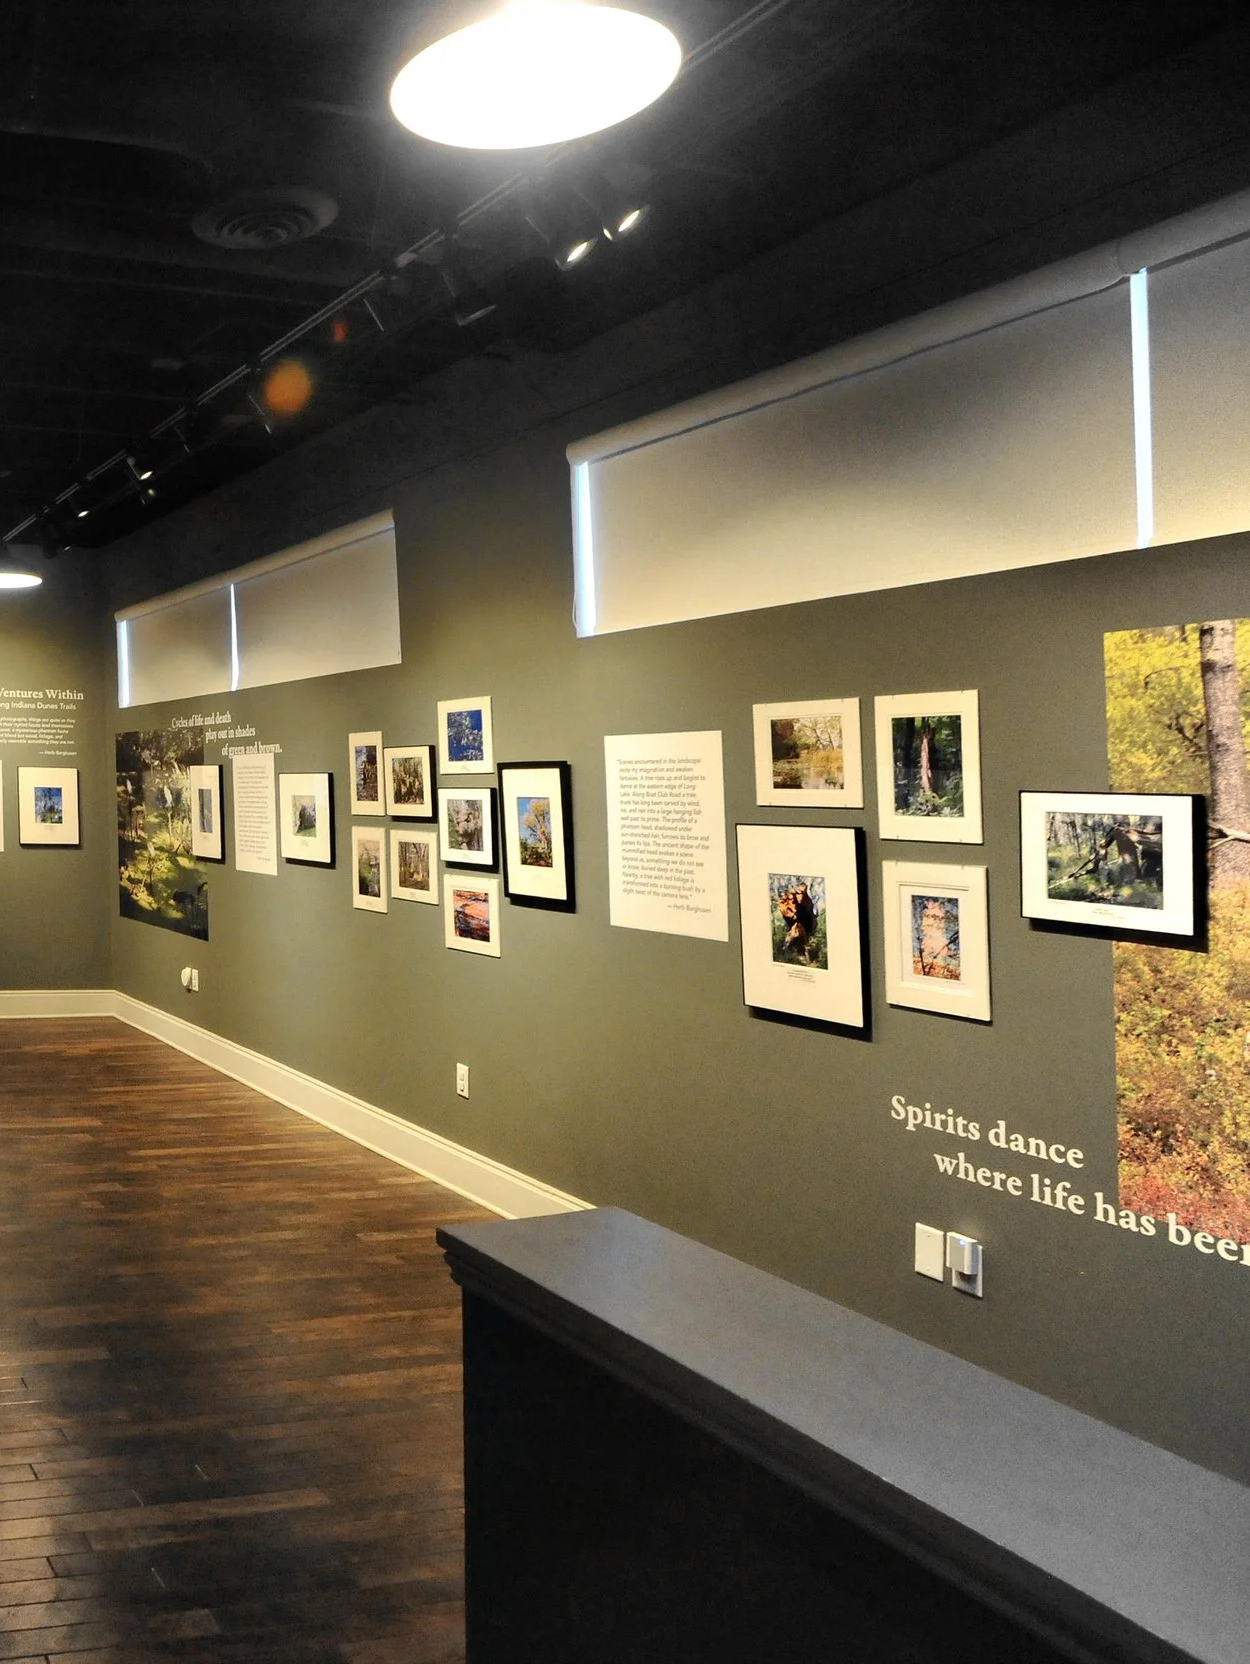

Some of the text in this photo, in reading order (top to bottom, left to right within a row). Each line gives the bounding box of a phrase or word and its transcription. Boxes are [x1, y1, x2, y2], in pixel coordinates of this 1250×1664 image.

[45, 689, 84, 700] Within
[11, 701, 36, 709] Indiana
[60, 702, 76, 710] Trails
[172, 710, 232, 730] Cycles of life and death
[206, 724, 256, 743] play out in shades
[222, 741, 282, 759] of green and brown.
[890, 1095, 1085, 1169] Spirits dance
[934, 1152, 1023, 1196] where
[1030, 1173, 1085, 1215] life
[1094, 1192, 1157, 1237] has
